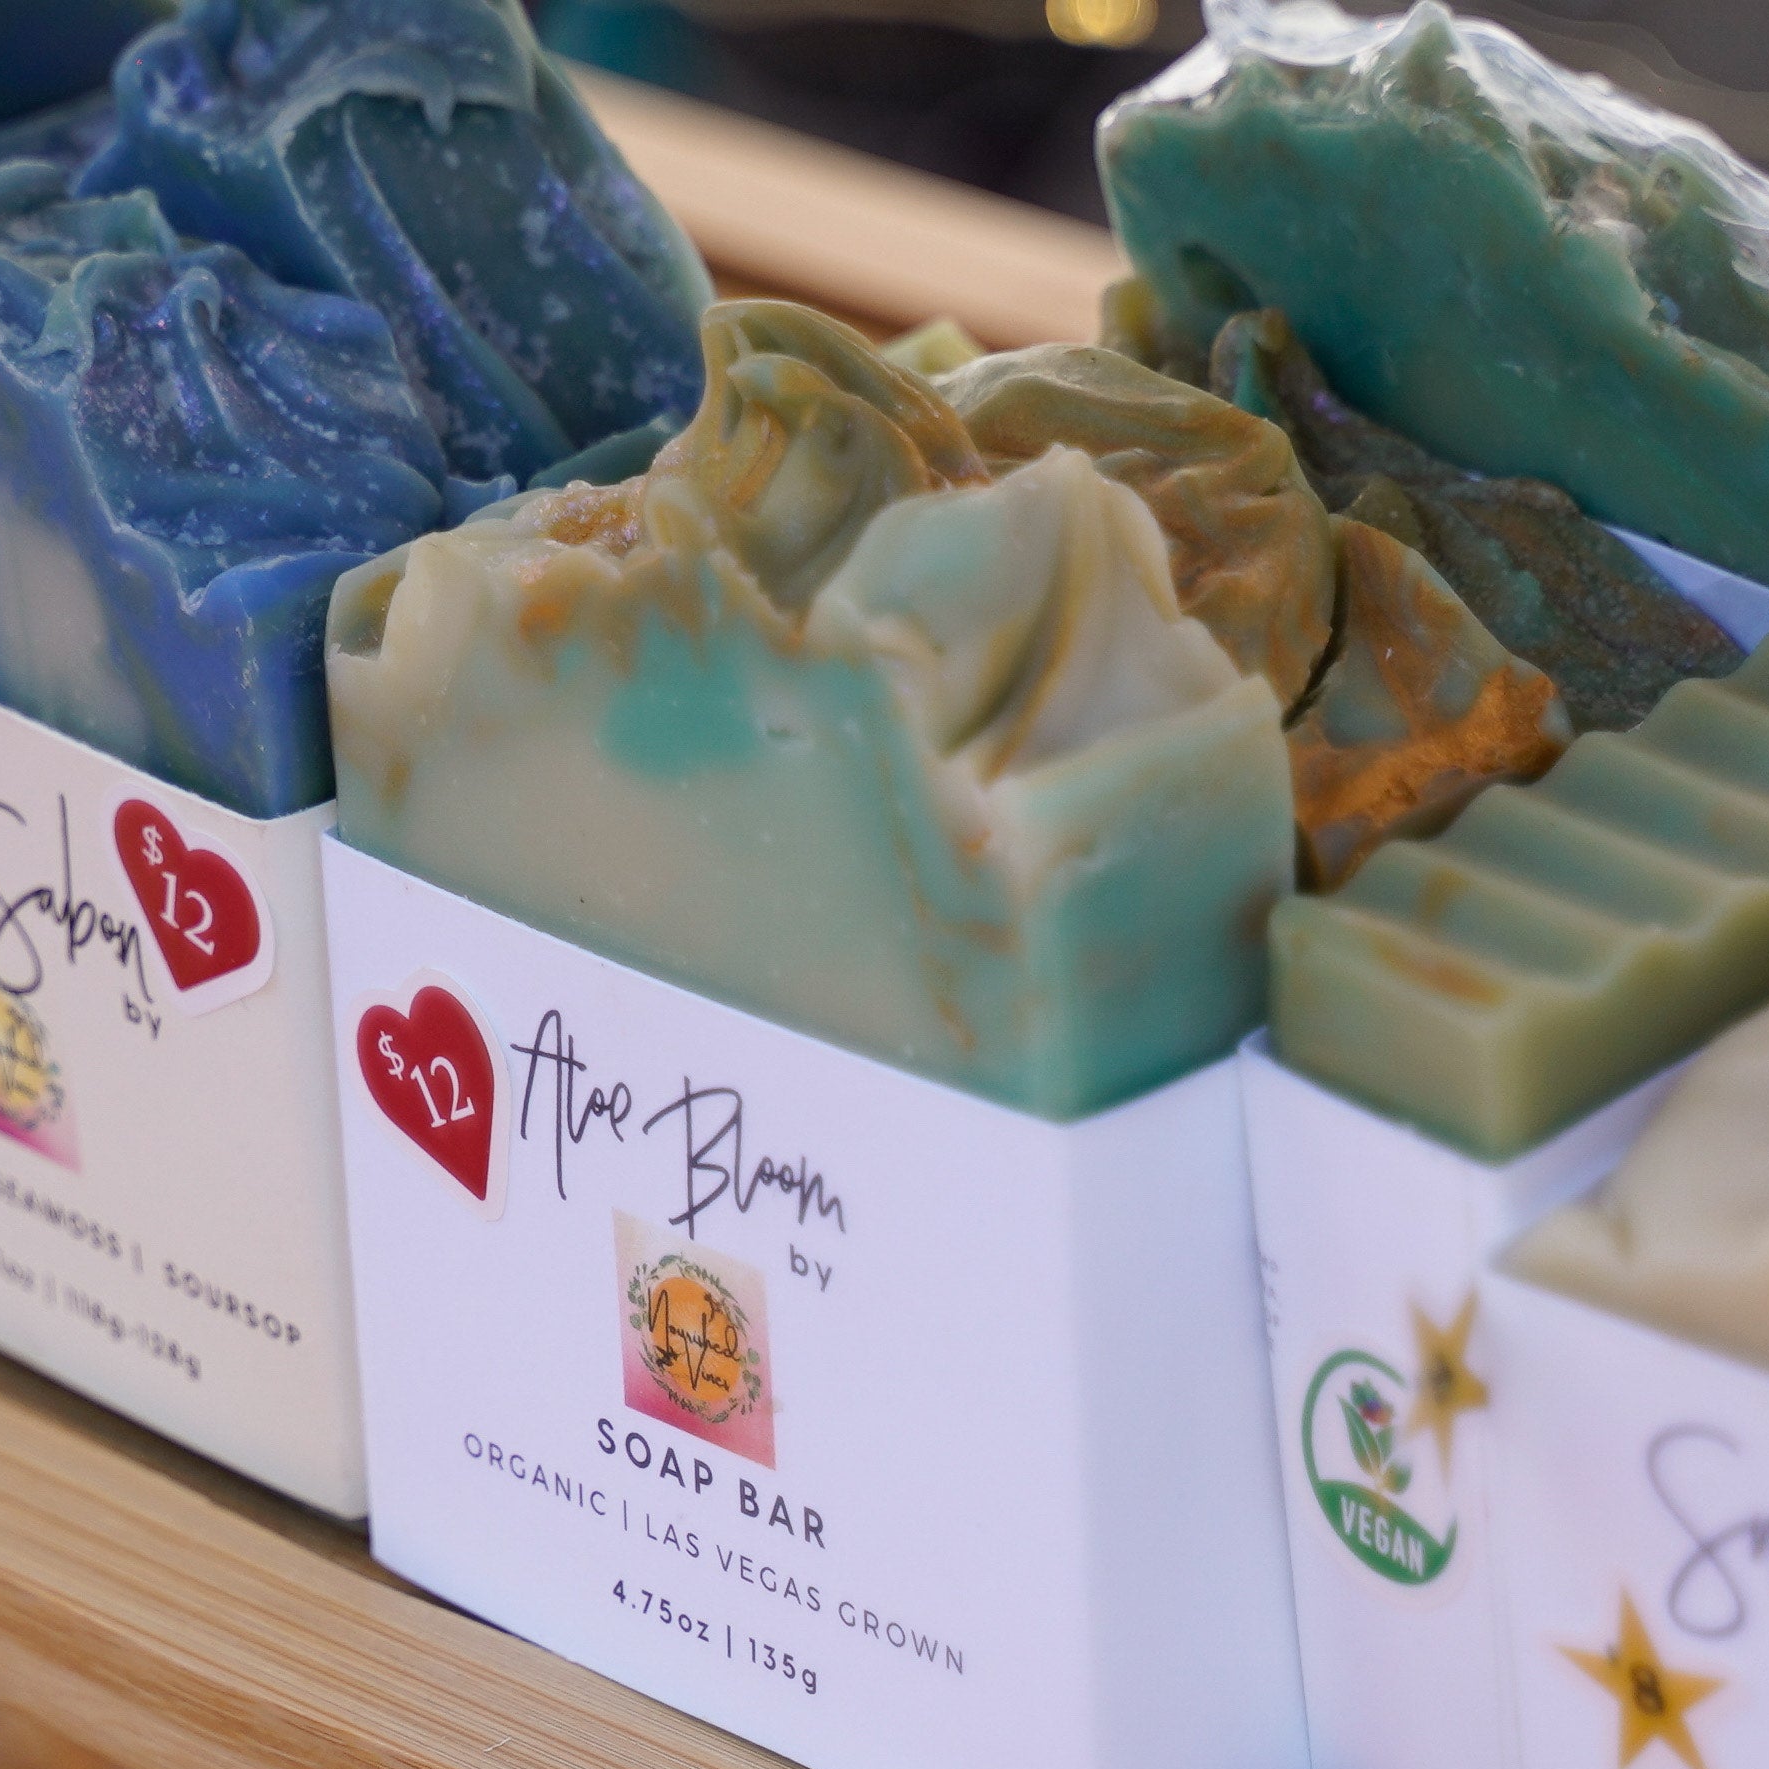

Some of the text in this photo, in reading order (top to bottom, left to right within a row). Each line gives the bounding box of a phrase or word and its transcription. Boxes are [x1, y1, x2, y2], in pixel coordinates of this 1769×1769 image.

[122, 992, 162, 1040] by
[510, 1009, 846, 1240] Aloe Bloom
[163, 1261, 301, 1344] SOURSOP
[790, 1244, 832, 1292] by
[597, 1417, 826, 1549] SOAP BAR
[464, 1433, 606, 1515] ORGANIC
[646, 1513, 699, 1558] LAS
[716, 1544, 821, 1612] VEGAS
[838, 1601, 964, 1676] GROWN
[1340, 1495, 1425, 1577] VEGAN
[613, 1580, 709, 1642] 4.75oz
[749, 1637, 817, 1694] 135g
